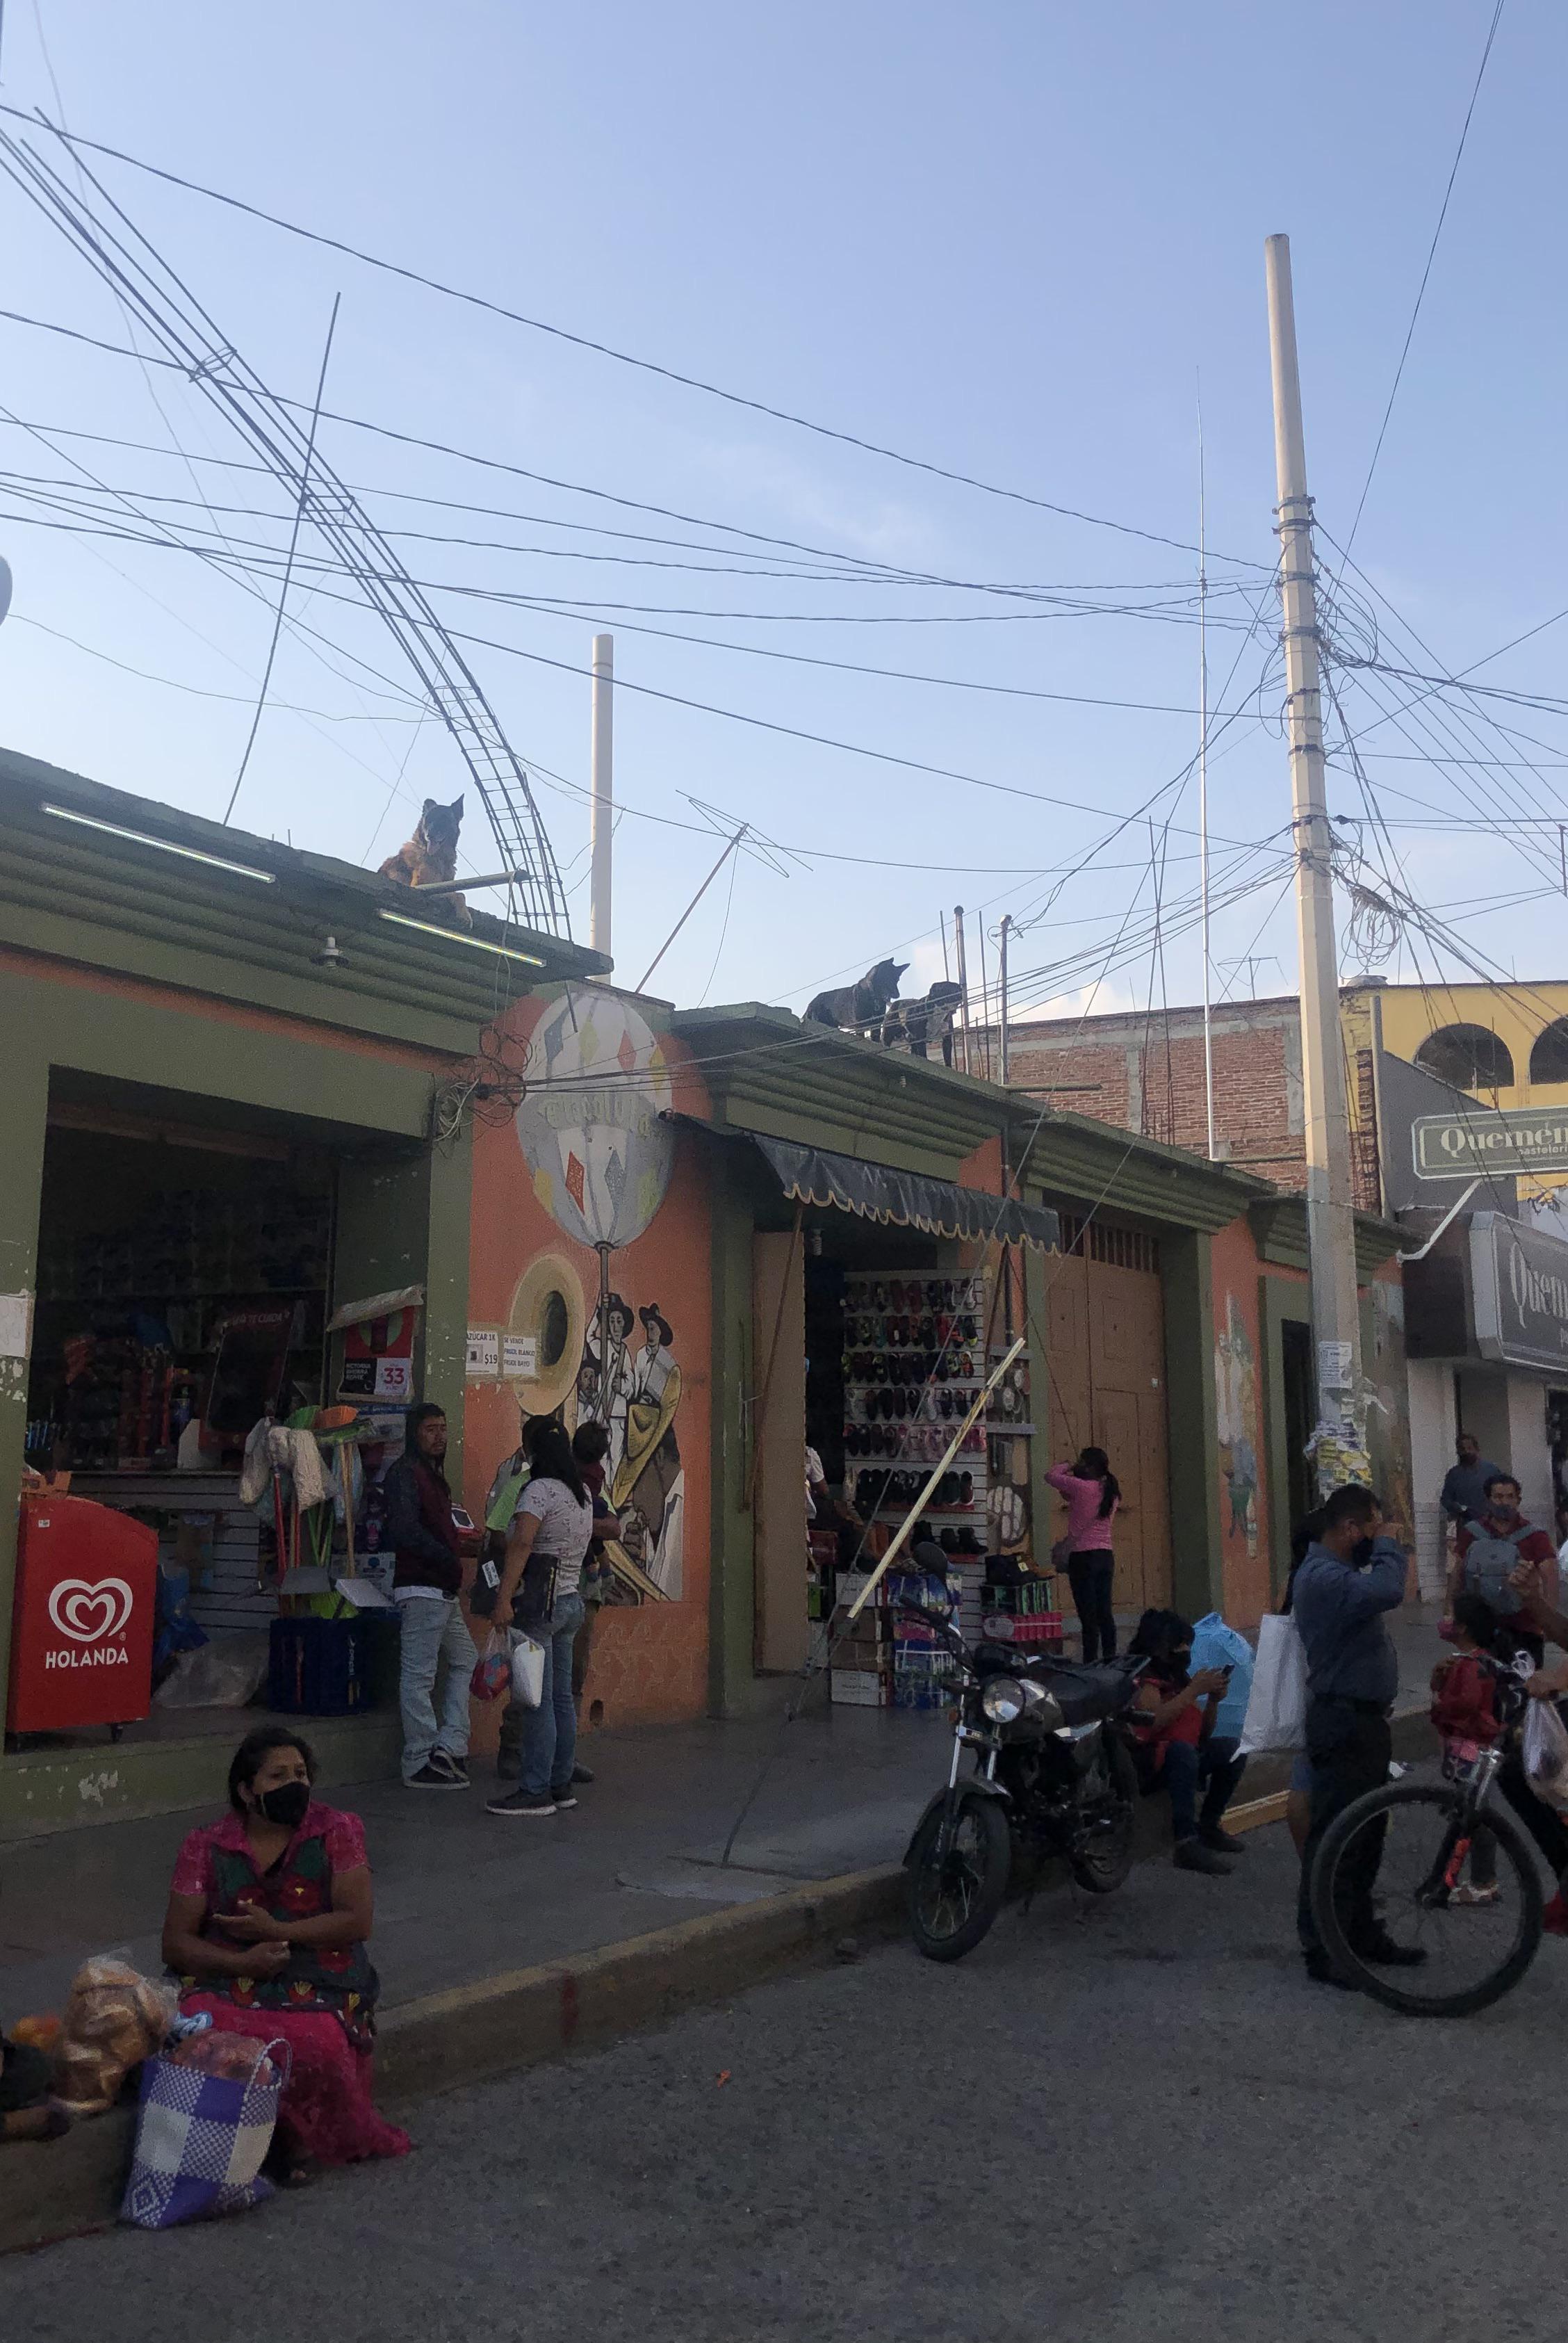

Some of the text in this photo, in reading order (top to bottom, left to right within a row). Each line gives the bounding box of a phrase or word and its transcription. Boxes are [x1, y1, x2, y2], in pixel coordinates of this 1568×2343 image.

[484, 1352, 498, 1365] $19
[384, 1368, 405, 1384] 33
[45, 1647, 129, 1669] HOLANDA
